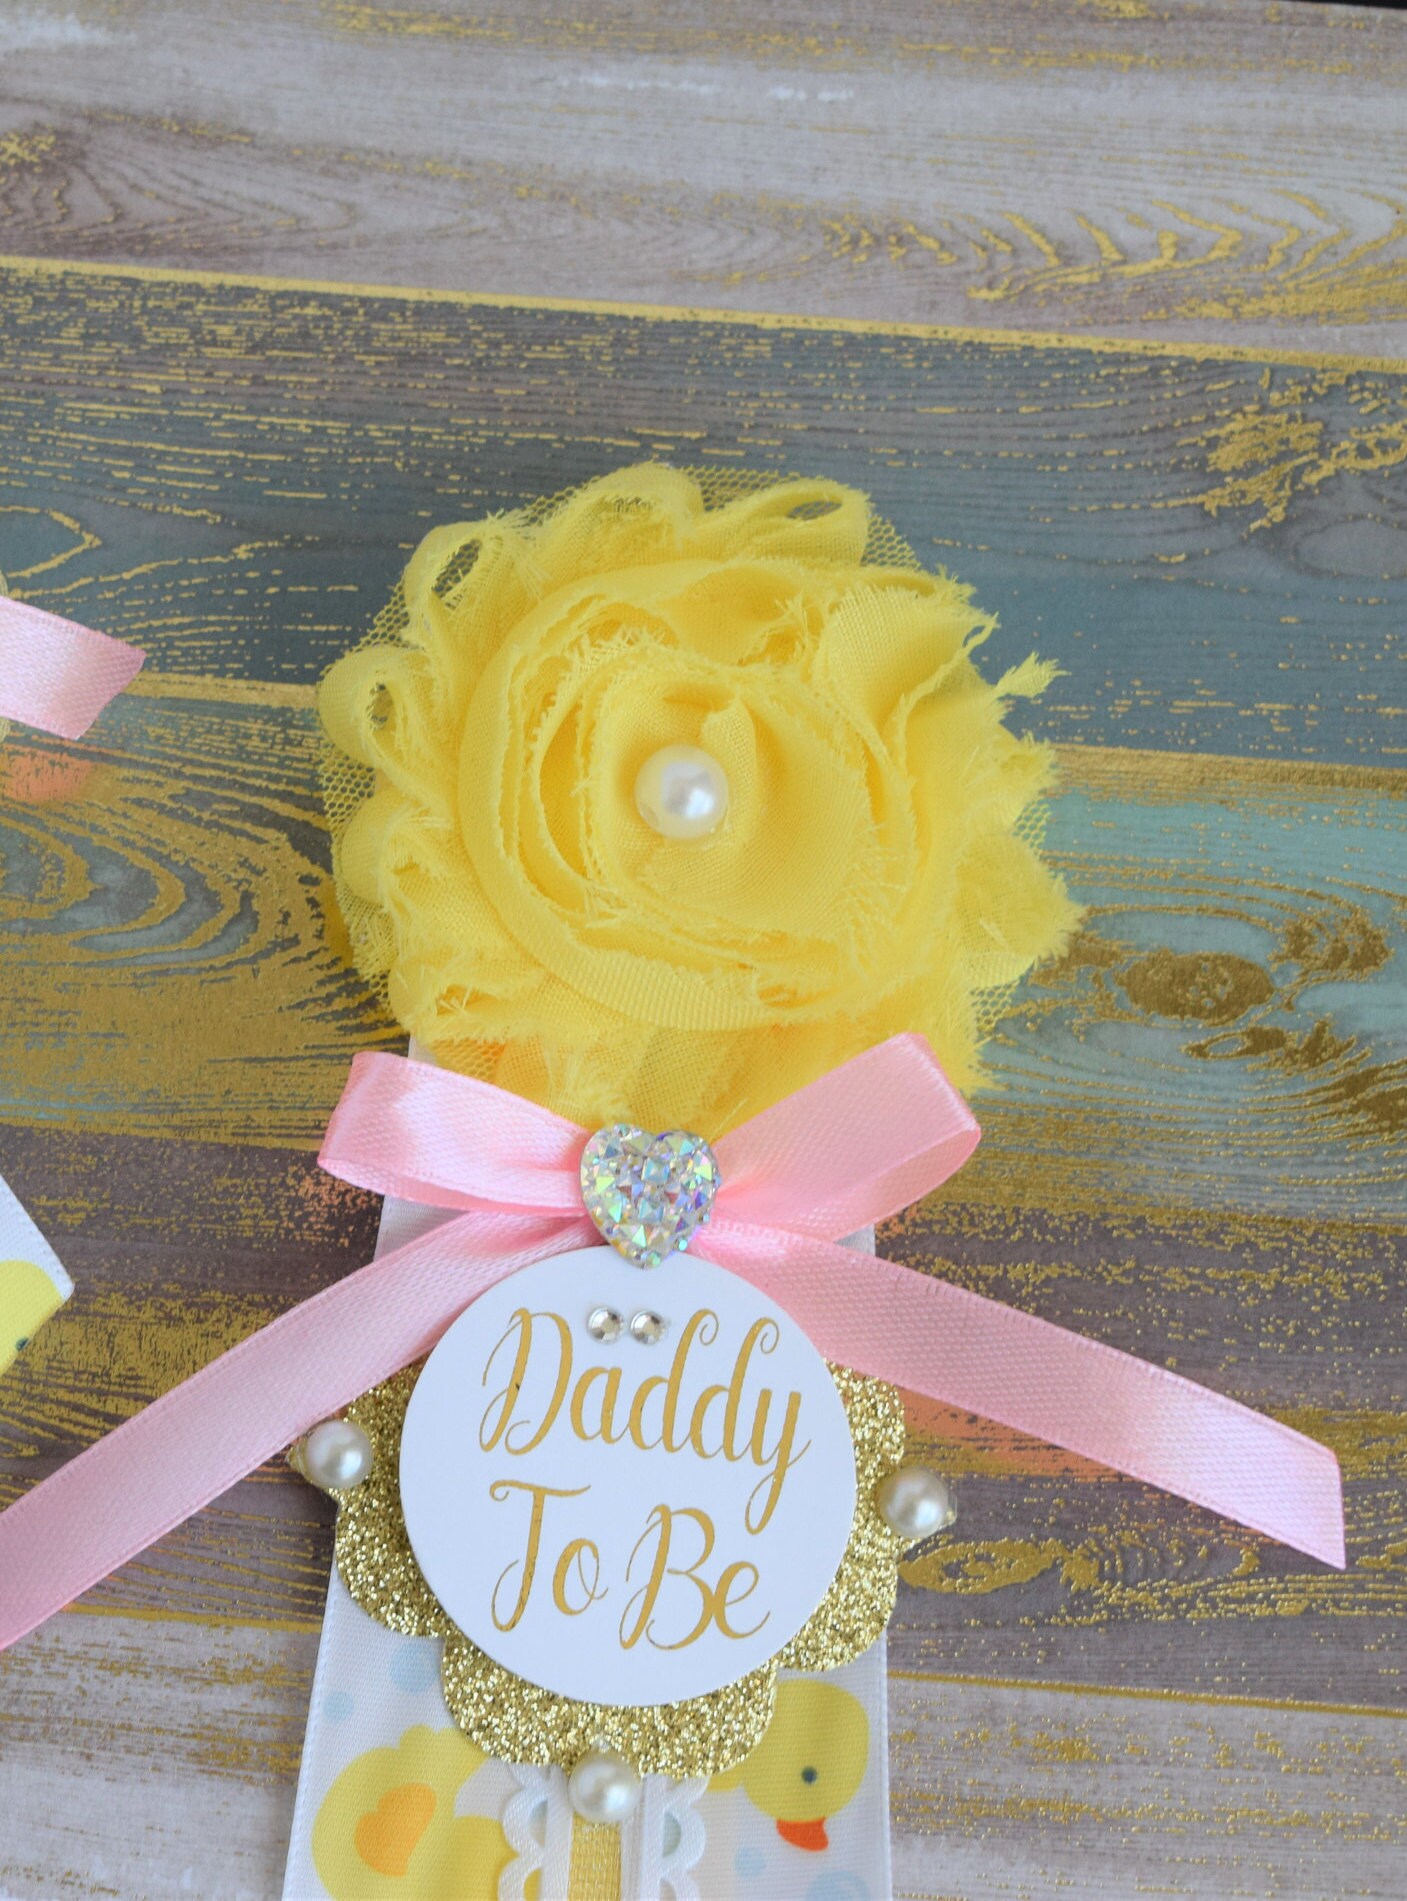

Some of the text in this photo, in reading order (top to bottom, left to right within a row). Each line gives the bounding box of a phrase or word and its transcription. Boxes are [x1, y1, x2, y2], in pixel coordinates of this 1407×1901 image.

[478, 1307, 812, 1535] Daddy
[488, 1479, 771, 1651] To Be
